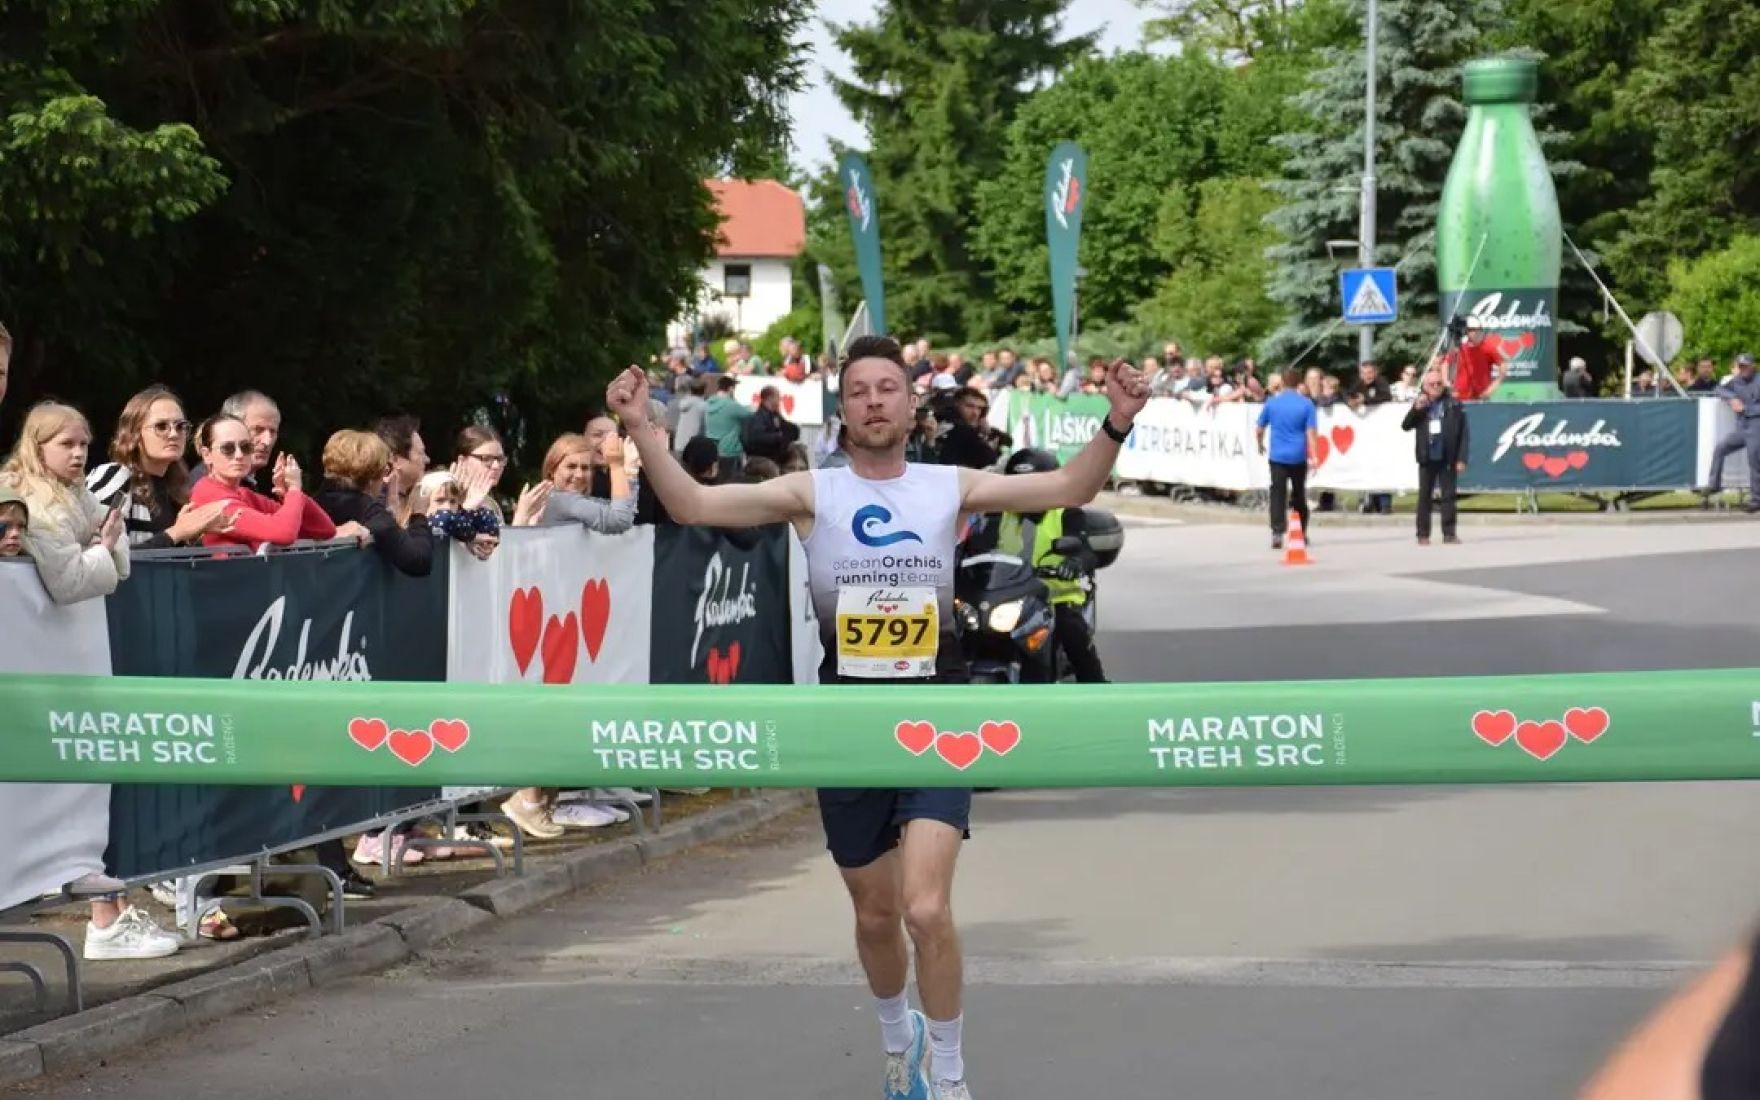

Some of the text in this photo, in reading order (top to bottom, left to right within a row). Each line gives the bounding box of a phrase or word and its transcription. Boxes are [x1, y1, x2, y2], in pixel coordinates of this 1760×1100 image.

[833, 555, 943, 570] oceanOrchids
[846, 618, 930, 646] 5797
[49, 711, 215, 737] MARATON
[591, 719, 758, 745] MARATON
[1147, 714, 1324, 742] MARATON
[52, 738, 216, 764] TREH SRC
[593, 749, 760, 770] TREH SRC
[1149, 744, 1324, 769] TREH SRC
